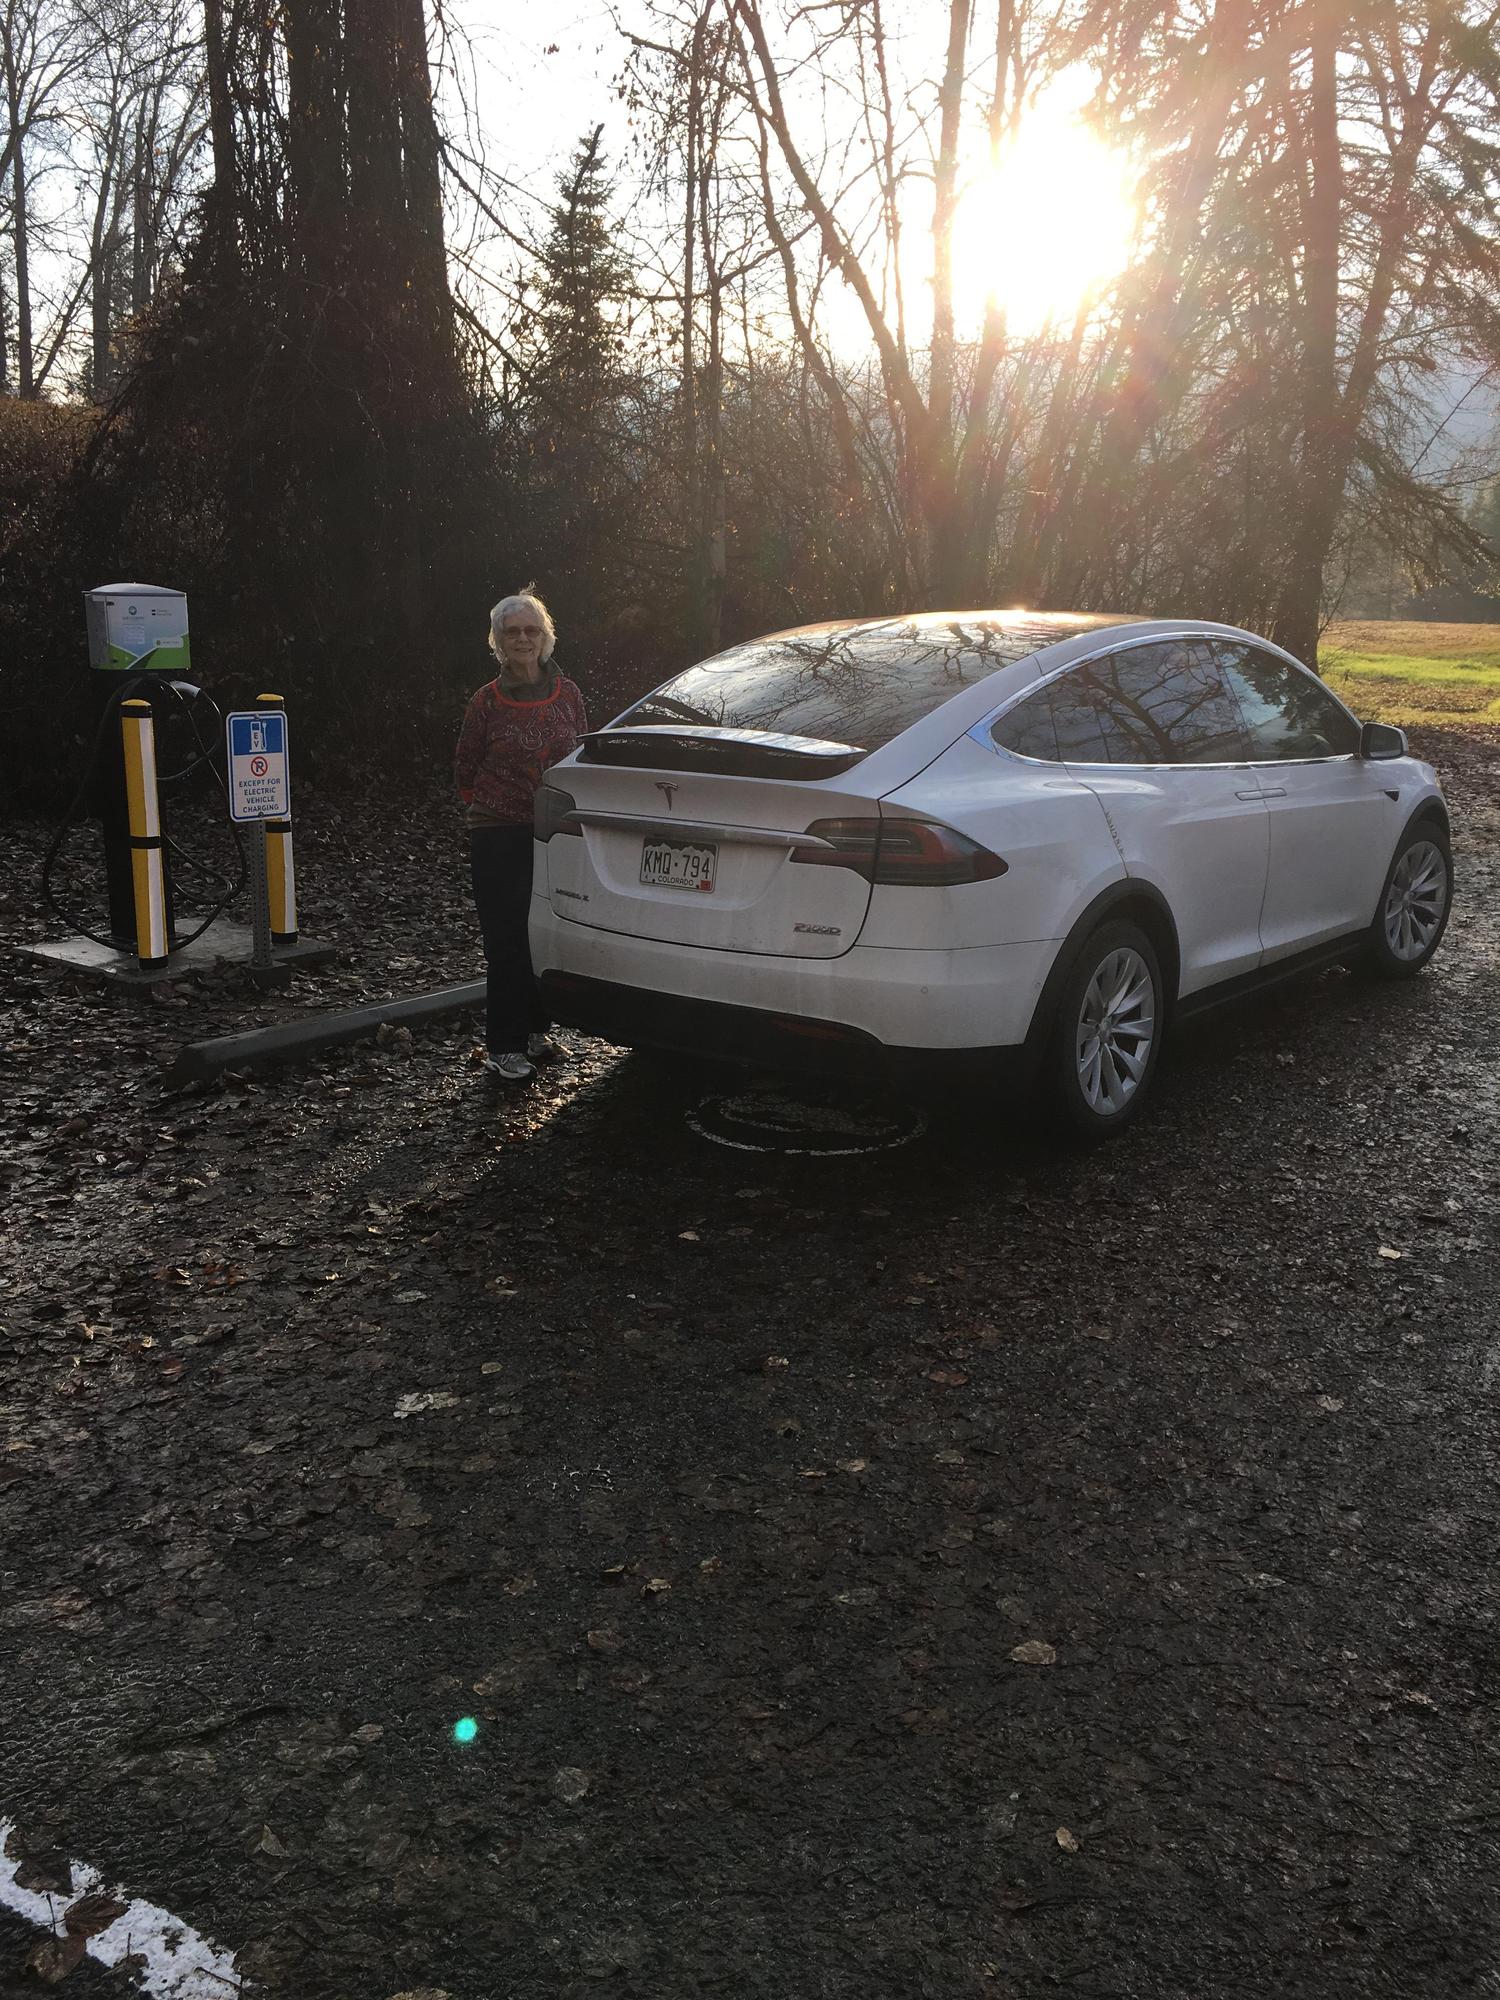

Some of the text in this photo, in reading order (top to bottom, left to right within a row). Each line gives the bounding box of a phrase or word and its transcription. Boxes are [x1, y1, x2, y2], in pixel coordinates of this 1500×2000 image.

[238, 777, 281, 788] EXCEPT FOR
[243, 787, 276, 796] ELECTRIC
[246, 795, 275, 804] VEHICLE
[242, 804, 280, 813] CHARGING
[657, 874, 694, 887] COLORADO
